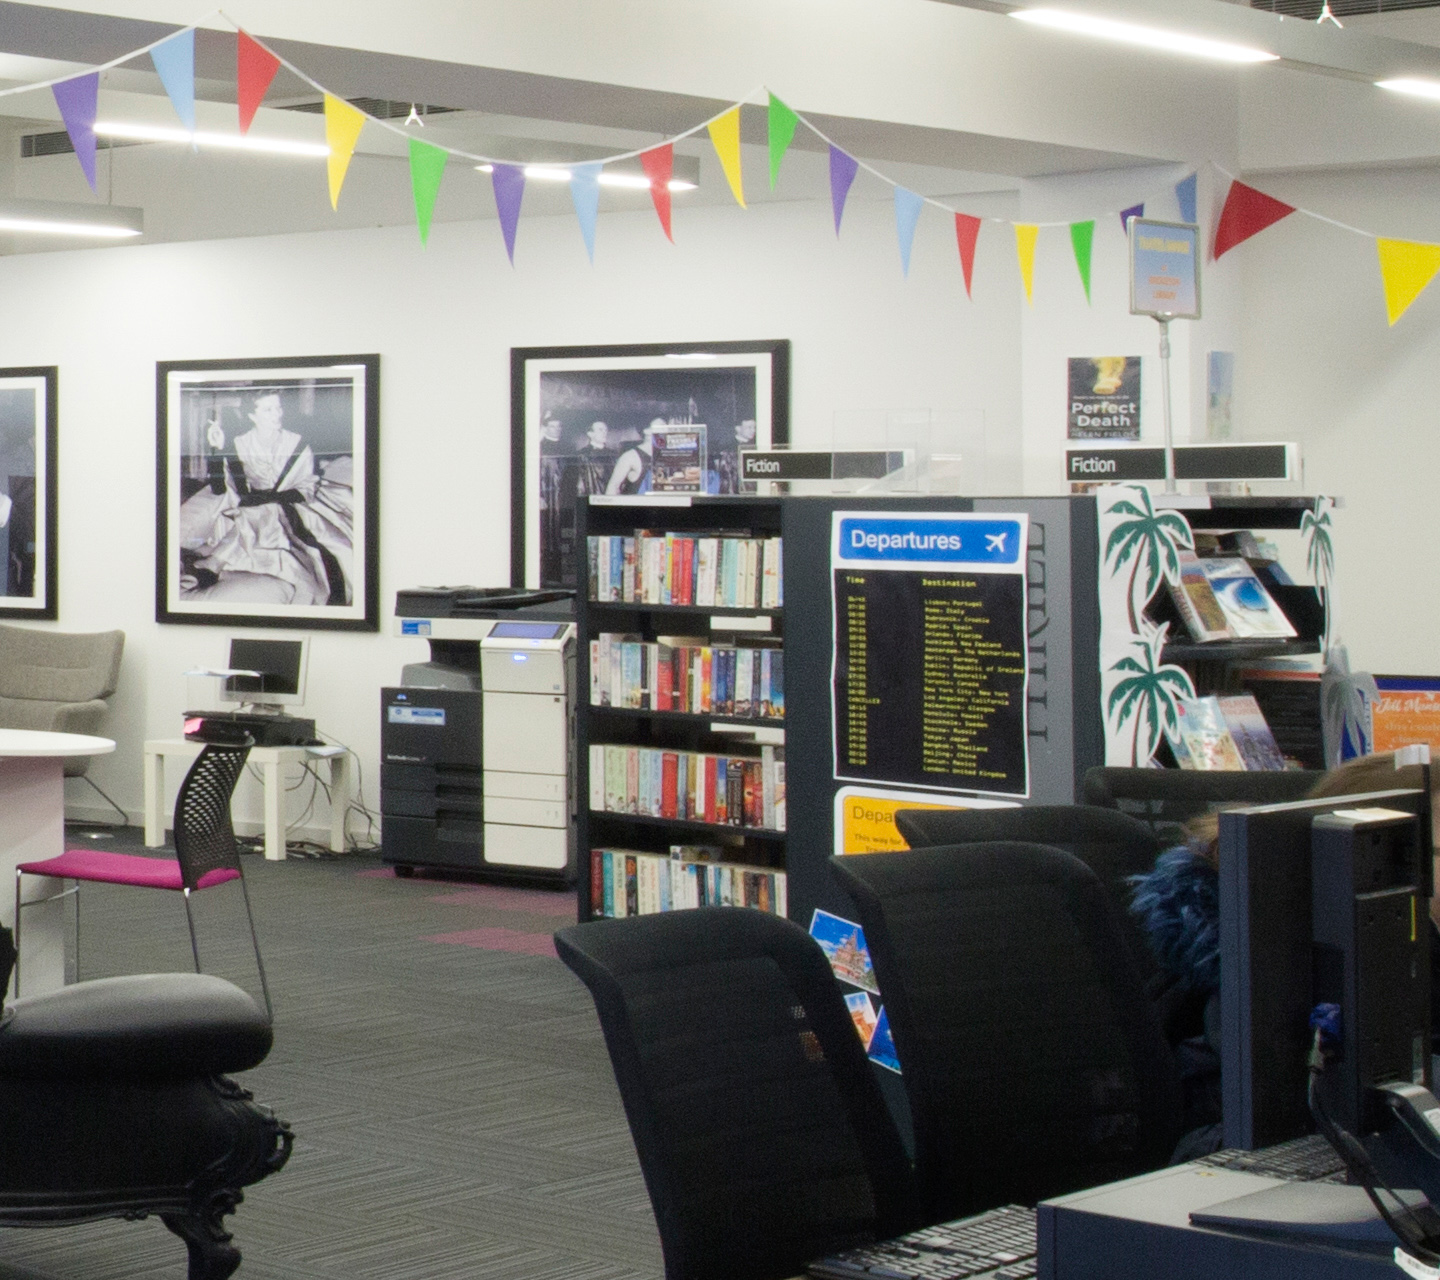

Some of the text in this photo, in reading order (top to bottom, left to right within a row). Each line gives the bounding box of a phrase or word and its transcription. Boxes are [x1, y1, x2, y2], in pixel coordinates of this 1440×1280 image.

[1071, 401, 1136, 415] Perfect
[1077, 414, 1131, 427] Death
[1071, 457, 1117, 474] Fiction
[850, 529, 962, 552] Departures
[846, 576, 977, 588] Time Destination
[852, 805, 893, 825] Depa
